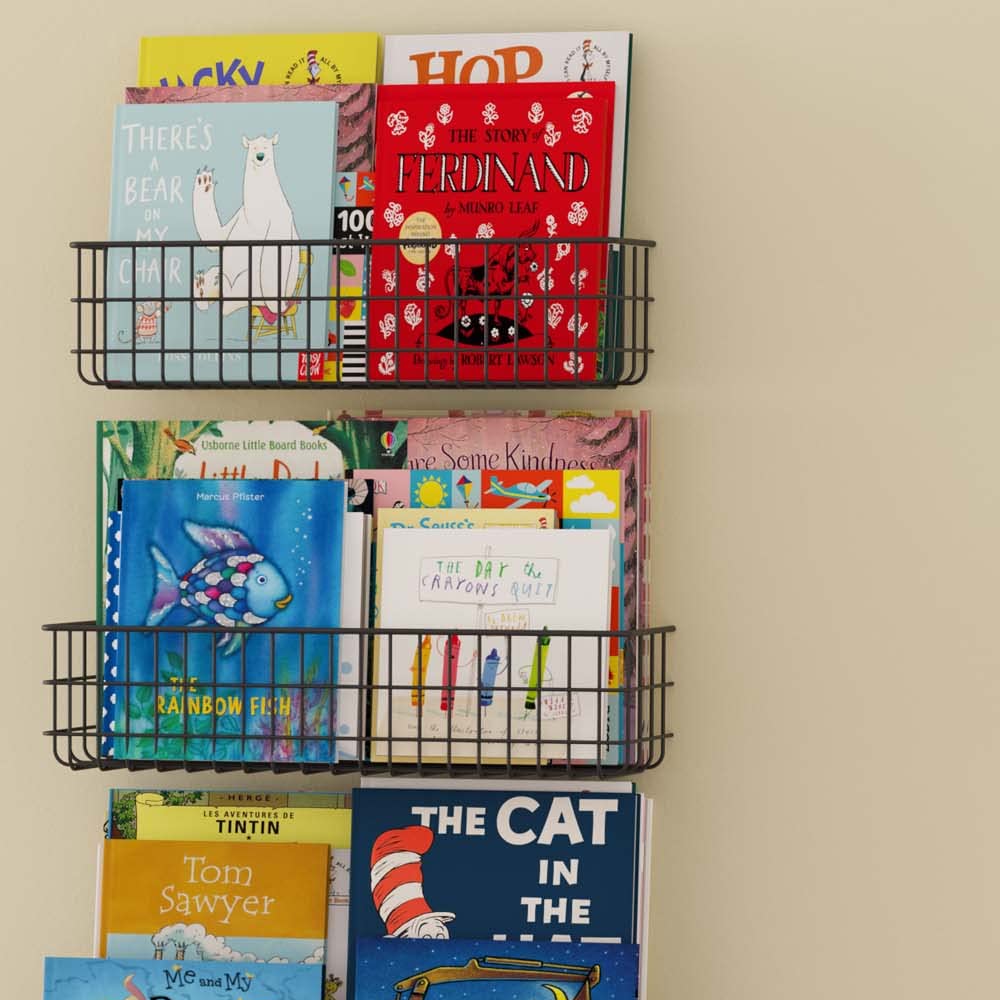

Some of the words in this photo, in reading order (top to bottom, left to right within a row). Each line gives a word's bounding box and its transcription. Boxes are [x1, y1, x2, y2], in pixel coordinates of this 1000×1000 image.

[409, 45, 543, 84] HOP
[121, 117, 214, 153] THERE'S
[450, 129, 477, 143] THE
[484, 128, 528, 144] STORY
[395, 152, 592, 194] FERDINAND
[125, 176, 184, 205] BEAR
[458, 201, 504, 215] MUNRO
[509, 200, 540, 214] LEAF
[201, 439, 240, 451] Usborne
[243, 439, 266, 451] Little
[269, 440, 297, 451] Board
[300, 440, 328, 452] Books
[441, 443, 499, 470] Some
[196, 492, 230, 501] Marcus
[436, 561, 462, 573] THE
[475, 560, 509, 579] DAY
[422, 574, 498, 597] CRAYONS
[203, 810, 219, 818] LES
[224, 811, 279, 819] AVENTURES
[283, 811, 295, 819] DE
[216, 820, 279, 834] TINTIN
[412, 806, 486, 835] THE
[496, 796, 618, 845] CAT
[183, 856, 253, 886] Tom
[539, 859, 579, 885] IN
[160, 884, 276, 924] Sawyer
[521, 897, 591, 924] THE
[164, 968, 196, 989] Me
[200, 978, 222, 988] and
[224, 972, 252, 992] My
